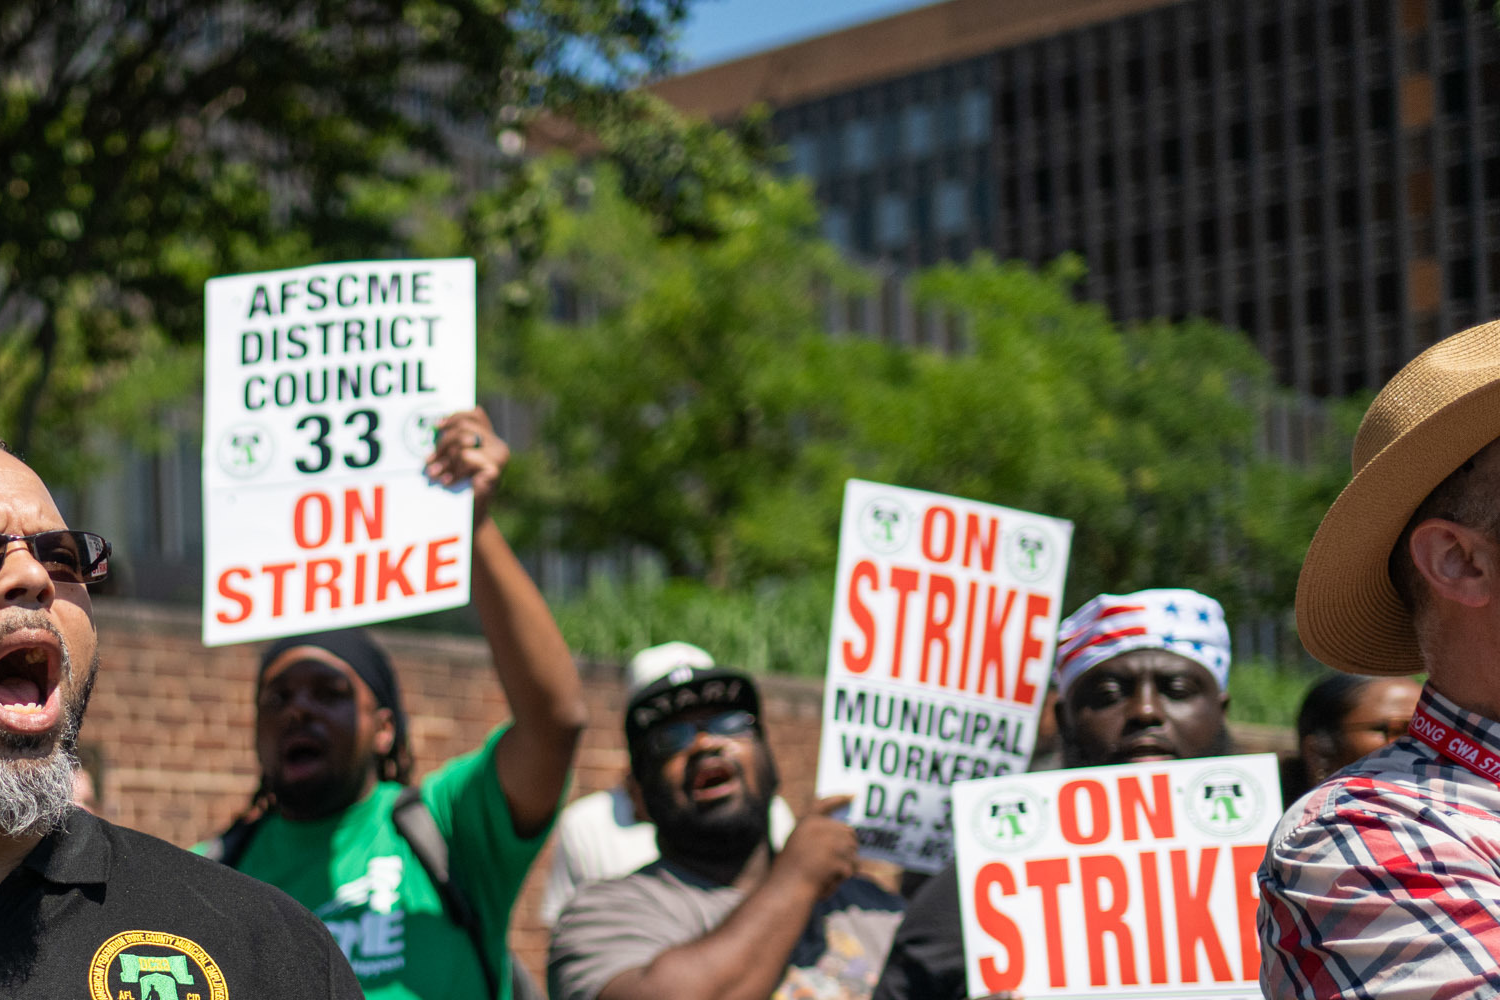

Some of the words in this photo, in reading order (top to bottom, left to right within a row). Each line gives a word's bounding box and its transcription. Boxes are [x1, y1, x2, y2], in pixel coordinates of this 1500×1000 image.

[247, 270, 433, 319] AFSCME
[240, 315, 442, 366] DISTRICT
[244, 360, 436, 411] COUNCIL
[294, 409, 381, 475] 33
[292, 485, 384, 550] ON
[920, 506, 999, 572] ON
[216, 535, 461, 625] STRIKE
[842, 560, 1051, 706] STRIKE
[834, 688, 1027, 757] MUNICIPAL
[1448, 738, 1480, 763] CWA
[864, 783, 922, 829] D.C.
[1057, 773, 1175, 845] ON
[138, 957, 171, 972] DC33
[118, 990, 135, 1000] AFL
